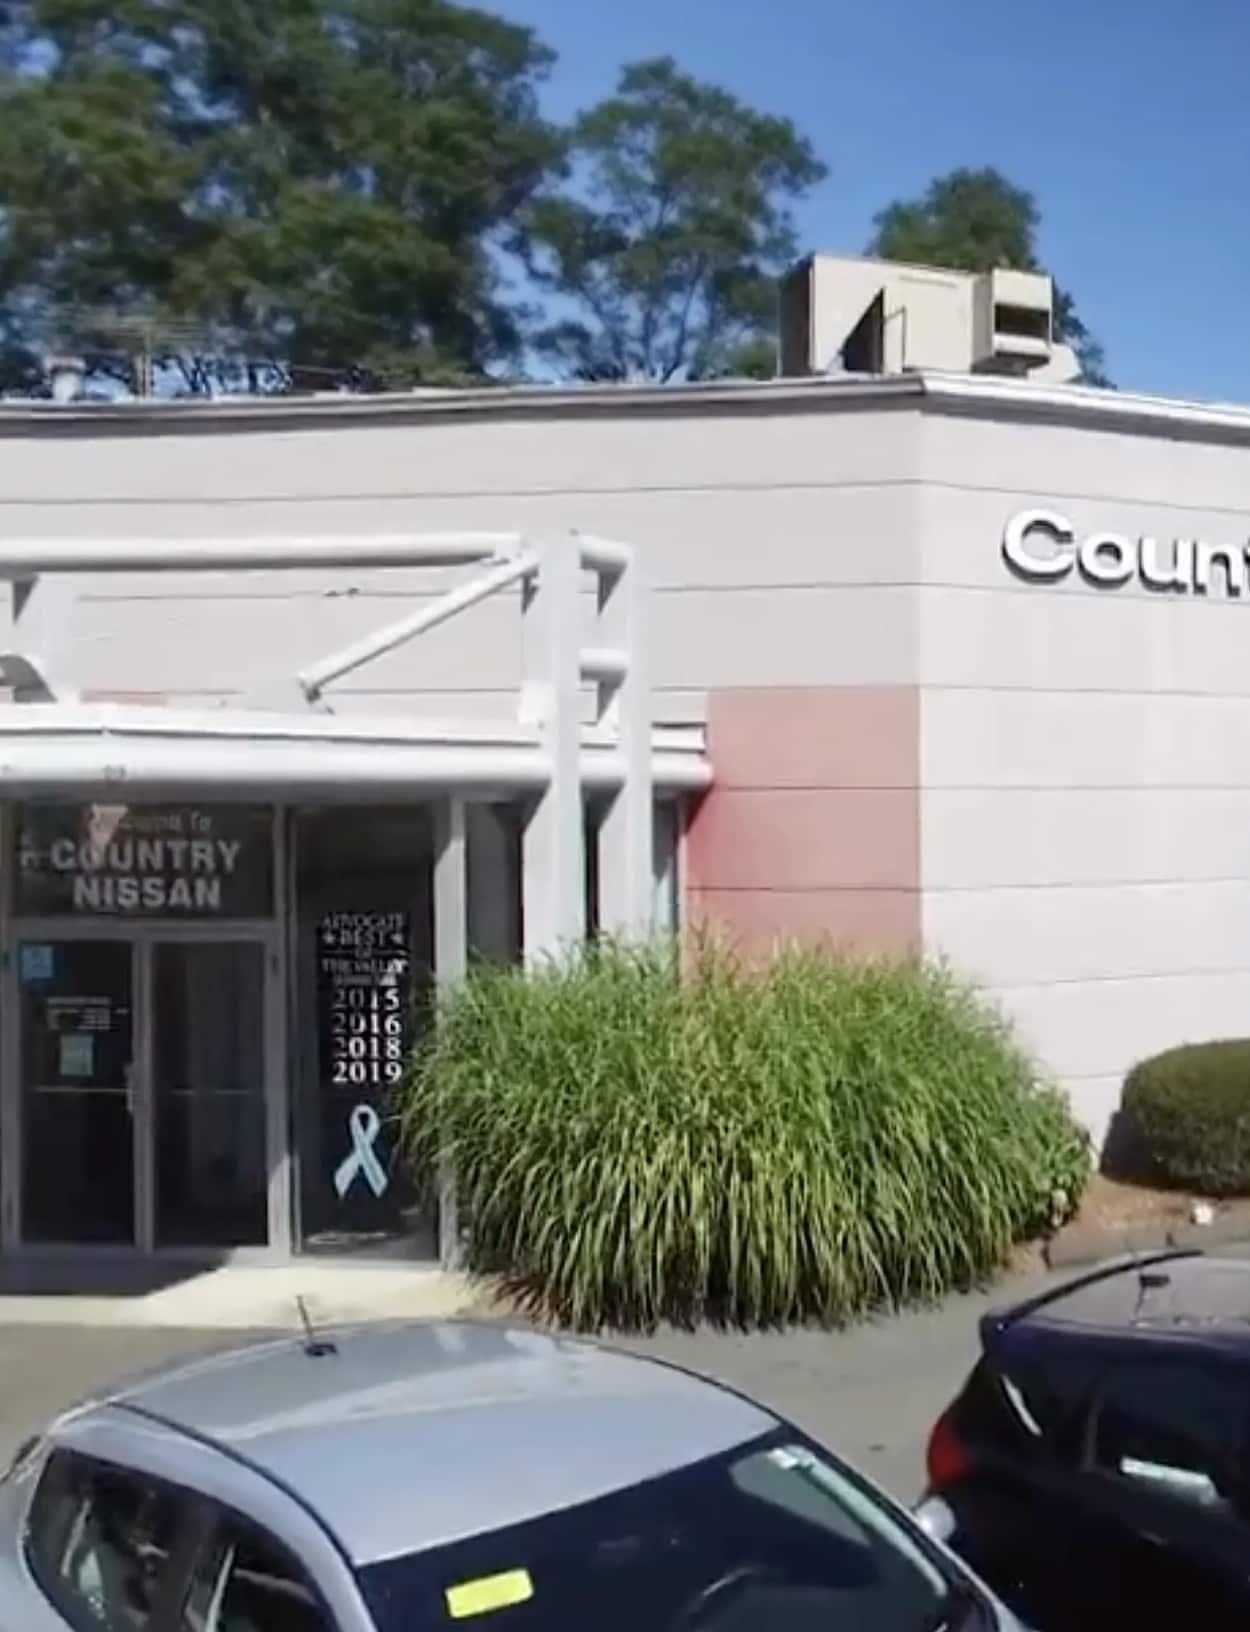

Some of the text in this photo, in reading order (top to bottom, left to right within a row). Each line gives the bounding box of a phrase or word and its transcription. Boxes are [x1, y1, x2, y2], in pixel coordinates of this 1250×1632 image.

[50, 838, 241, 873] COUNTRY
[73, 875, 222, 909] NISSAN
[333, 988, 401, 1011] 2015
[333, 1012, 402, 1036] 2016
[333, 1036, 402, 1060] 2018
[332, 1060, 403, 1084] 2019
